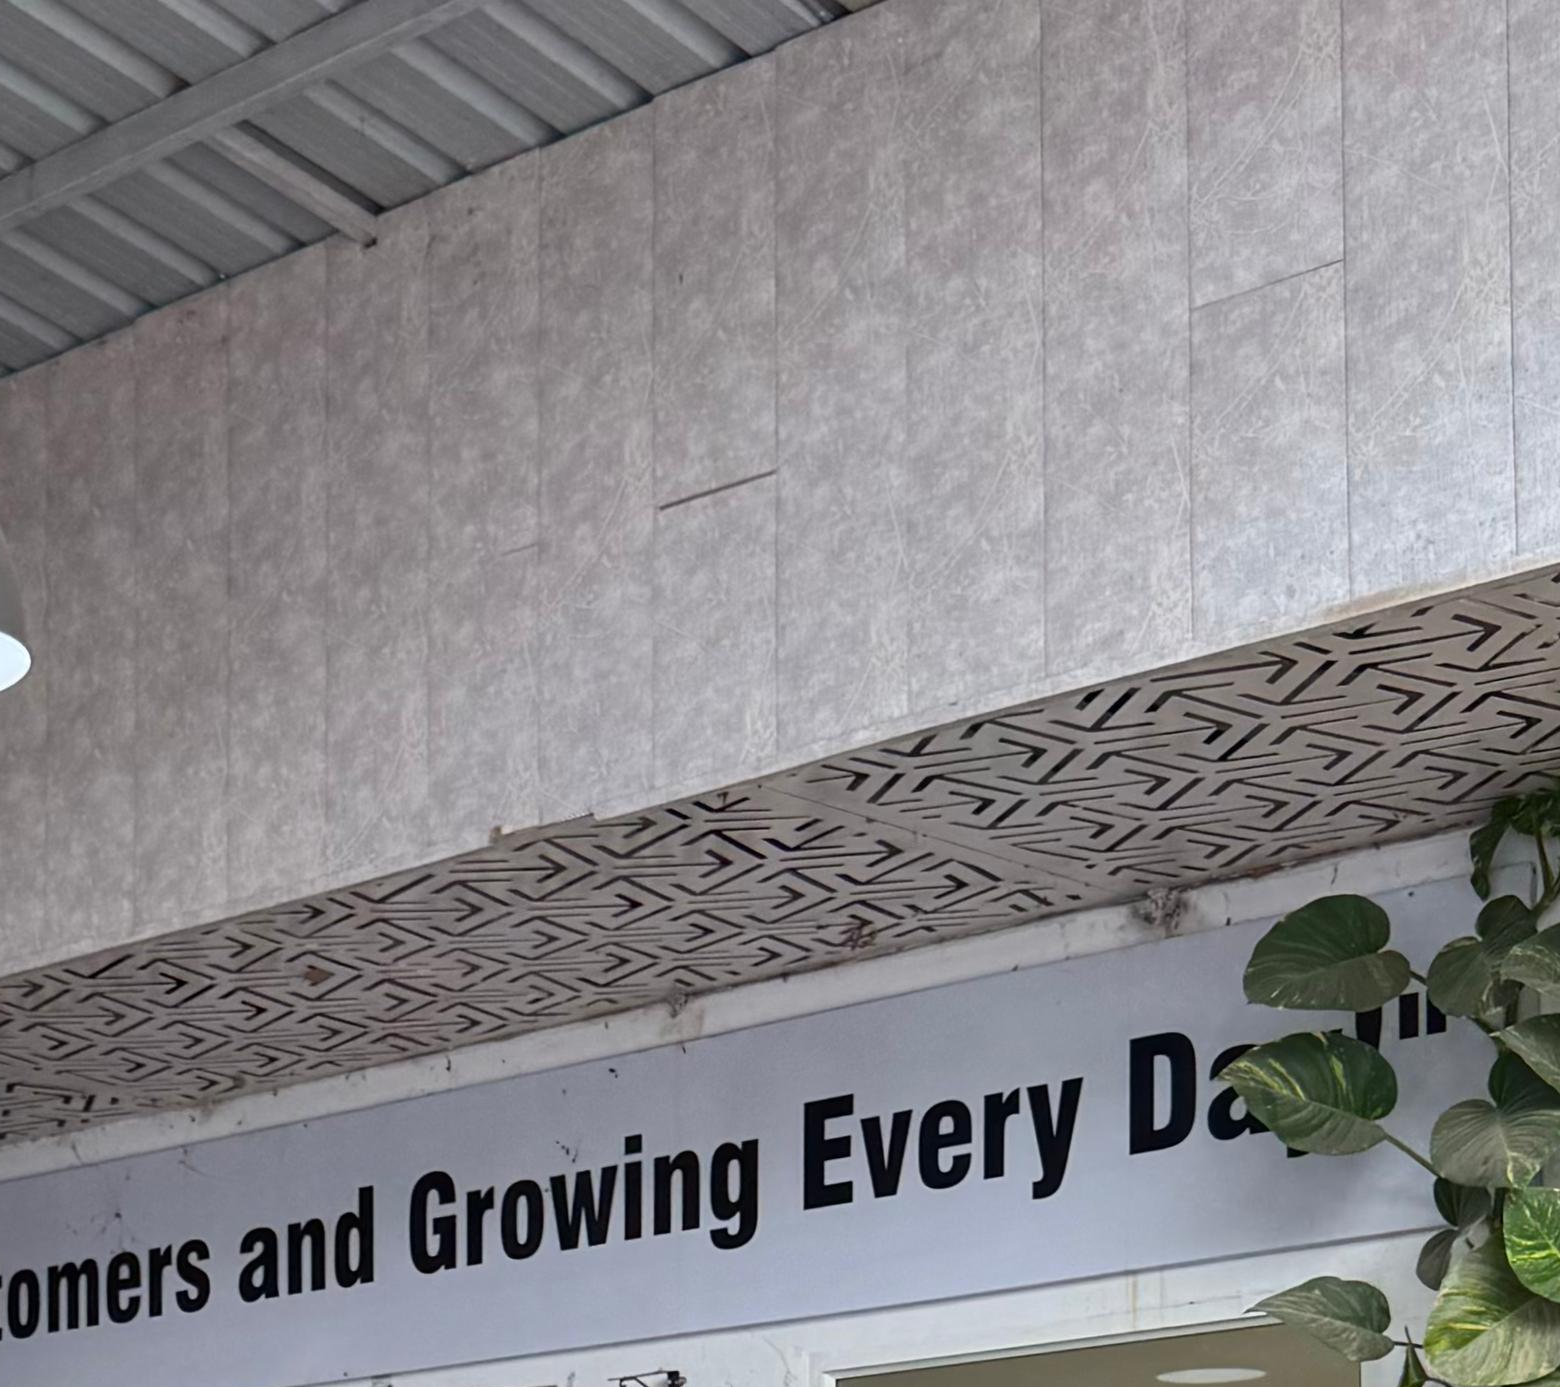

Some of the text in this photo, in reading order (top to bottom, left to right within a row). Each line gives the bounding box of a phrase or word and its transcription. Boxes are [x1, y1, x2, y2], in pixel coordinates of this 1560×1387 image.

[239, 1185, 375, 1302] and
[409, 1134, 759, 1275] Growing
[803, 1075, 1083, 1211] Every
